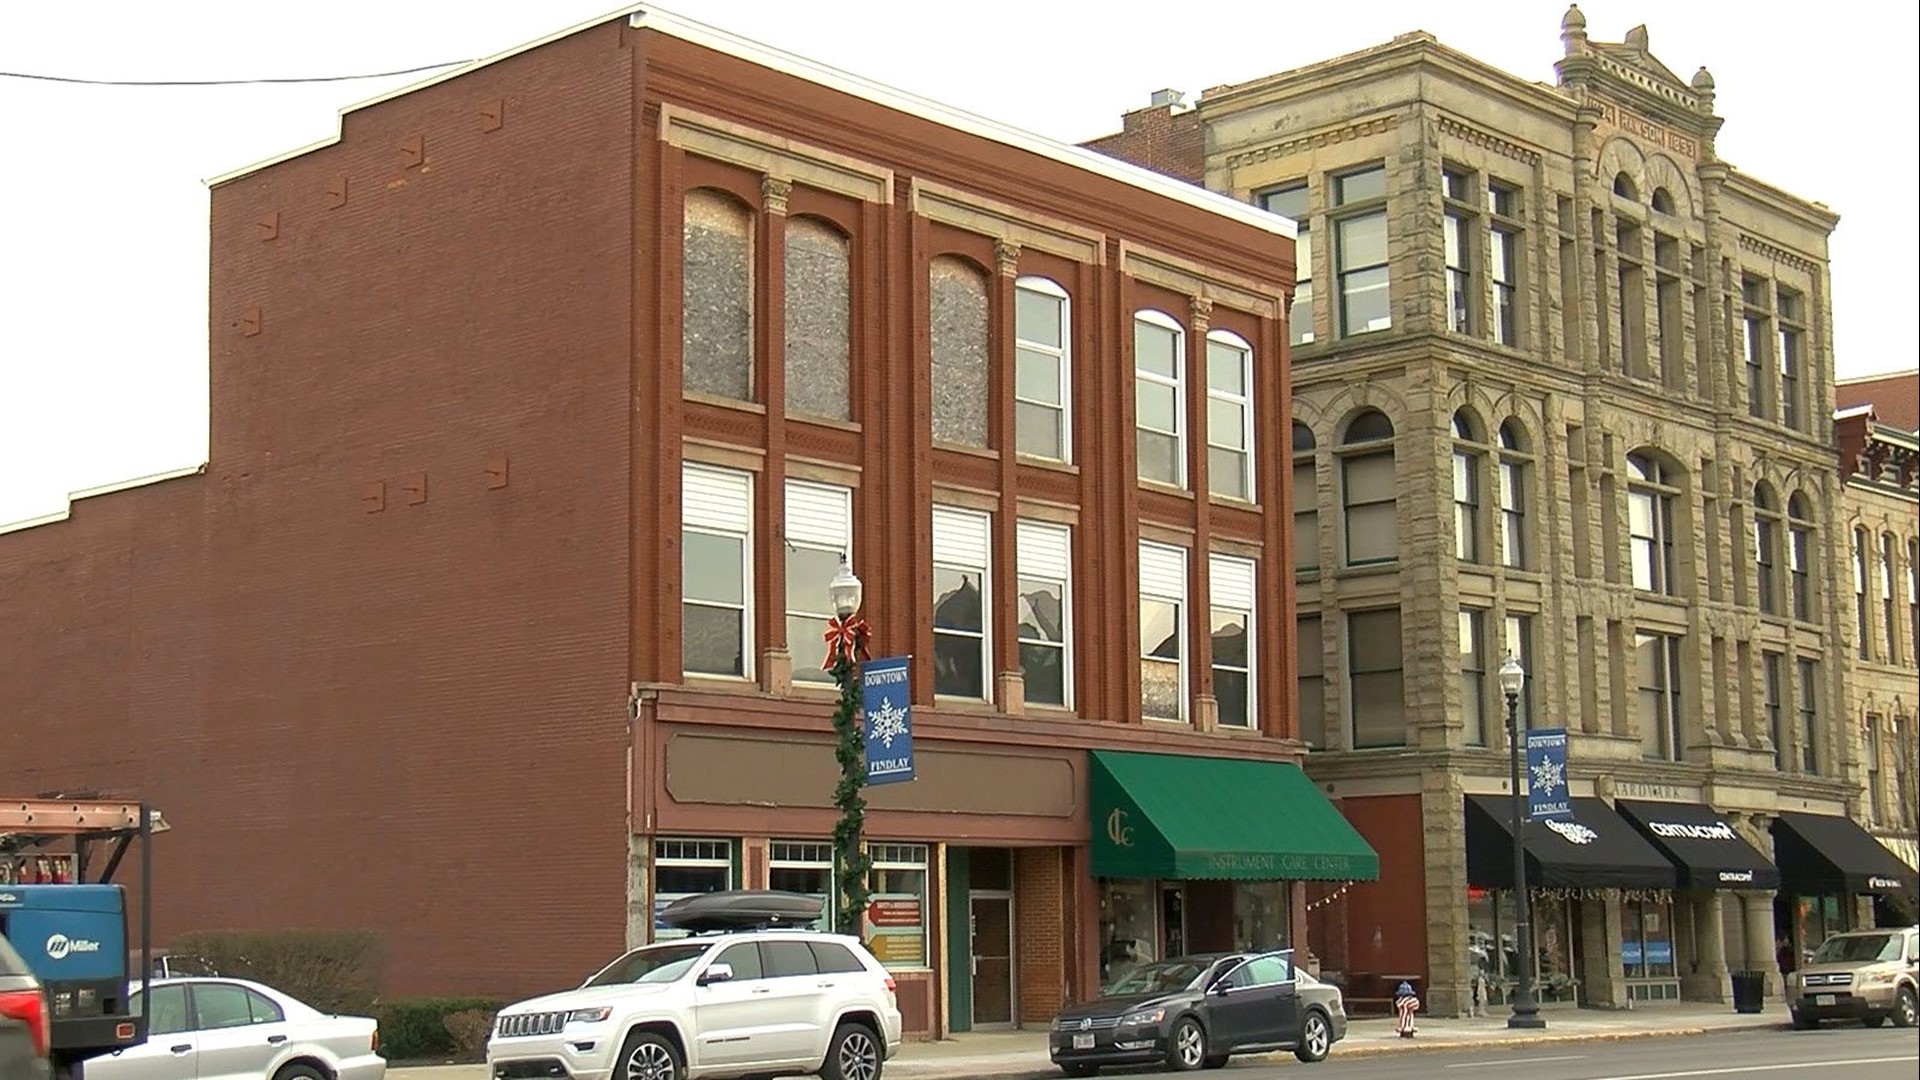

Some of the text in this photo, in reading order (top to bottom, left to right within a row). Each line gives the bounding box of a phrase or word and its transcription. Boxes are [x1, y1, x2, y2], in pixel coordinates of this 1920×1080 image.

[865, 671, 907, 686] DOWNTOWN
[1528, 739, 1565, 749] DOWNTOWN
[871, 758, 909, 772] FINDLAY
[1534, 802, 1568, 812] FINDLAY
[1209, 853, 1350, 870] INSTRUMENT CARE CENTER
[70, 940, 99, 952] Miller
